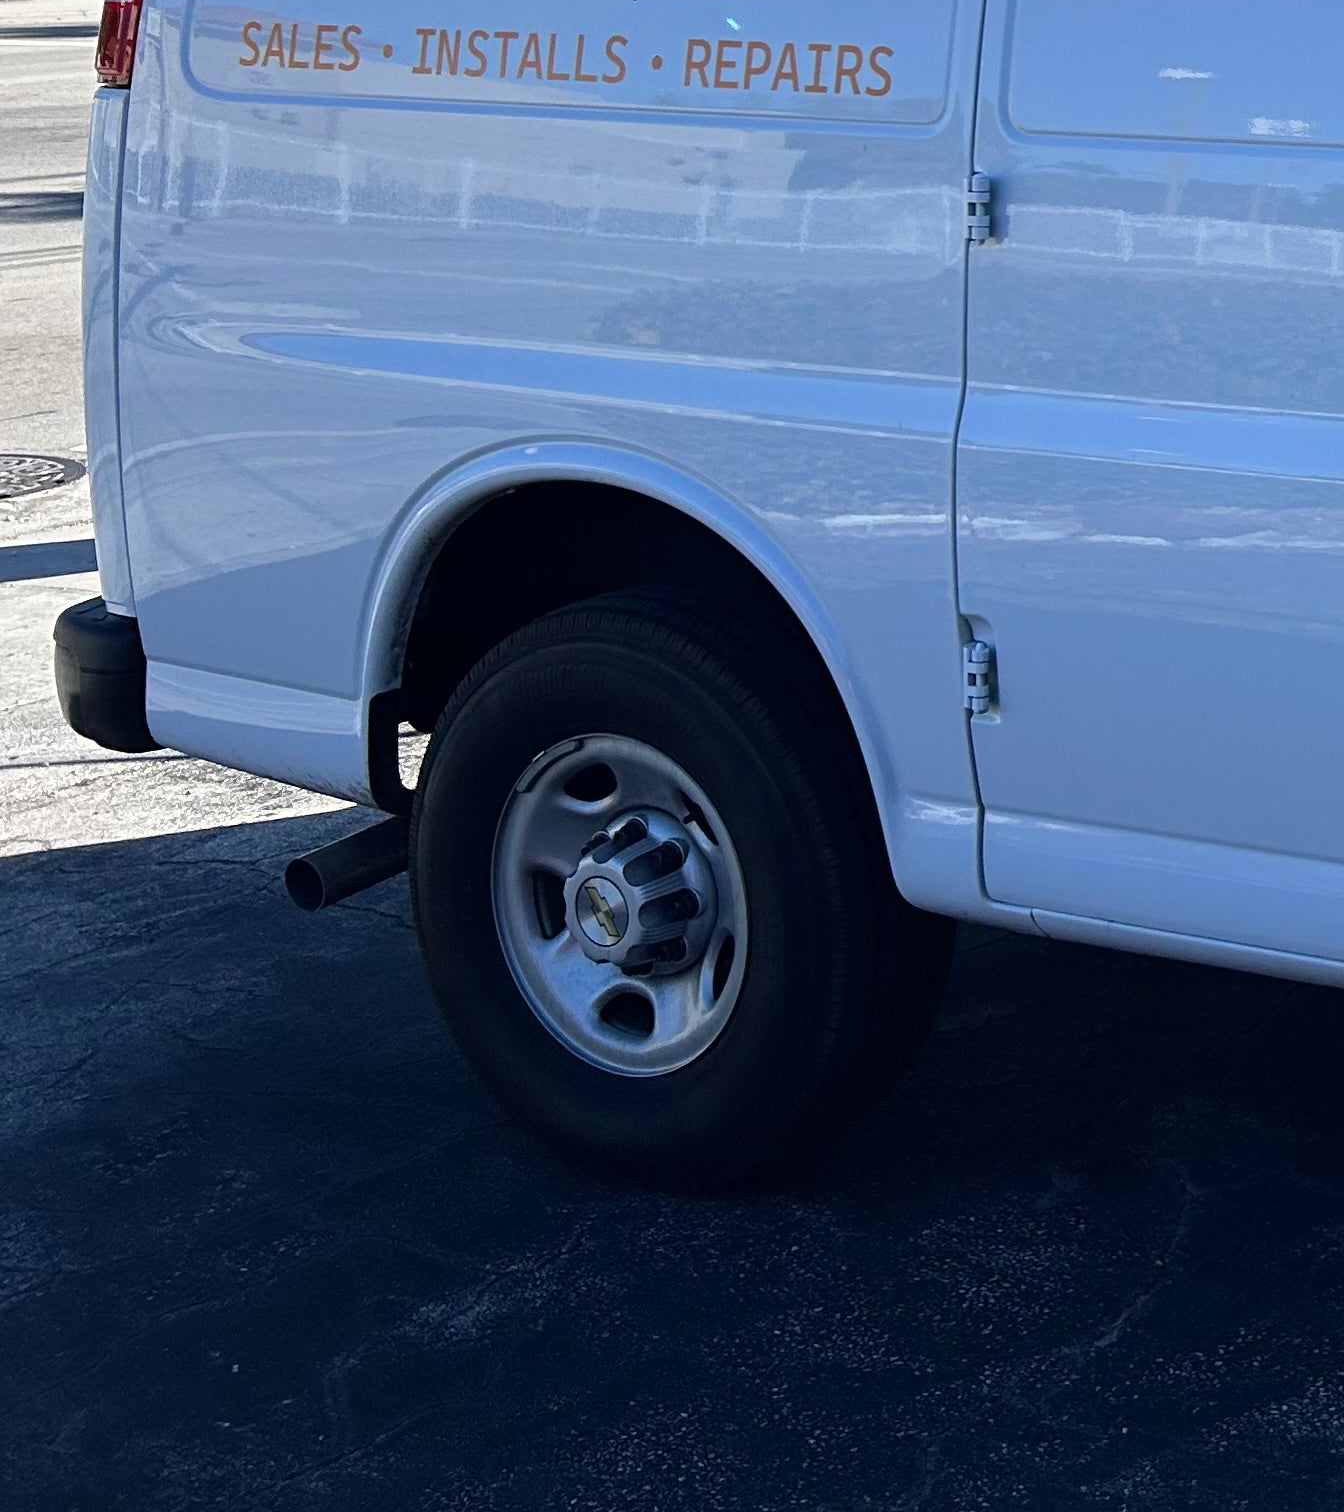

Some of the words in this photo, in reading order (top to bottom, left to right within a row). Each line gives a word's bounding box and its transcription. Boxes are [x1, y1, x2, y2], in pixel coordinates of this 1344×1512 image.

[238, 20, 362, 72] SALES
[411, 28, 629, 85] INSTALLS
[683, 38, 894, 97] REPAIRS
